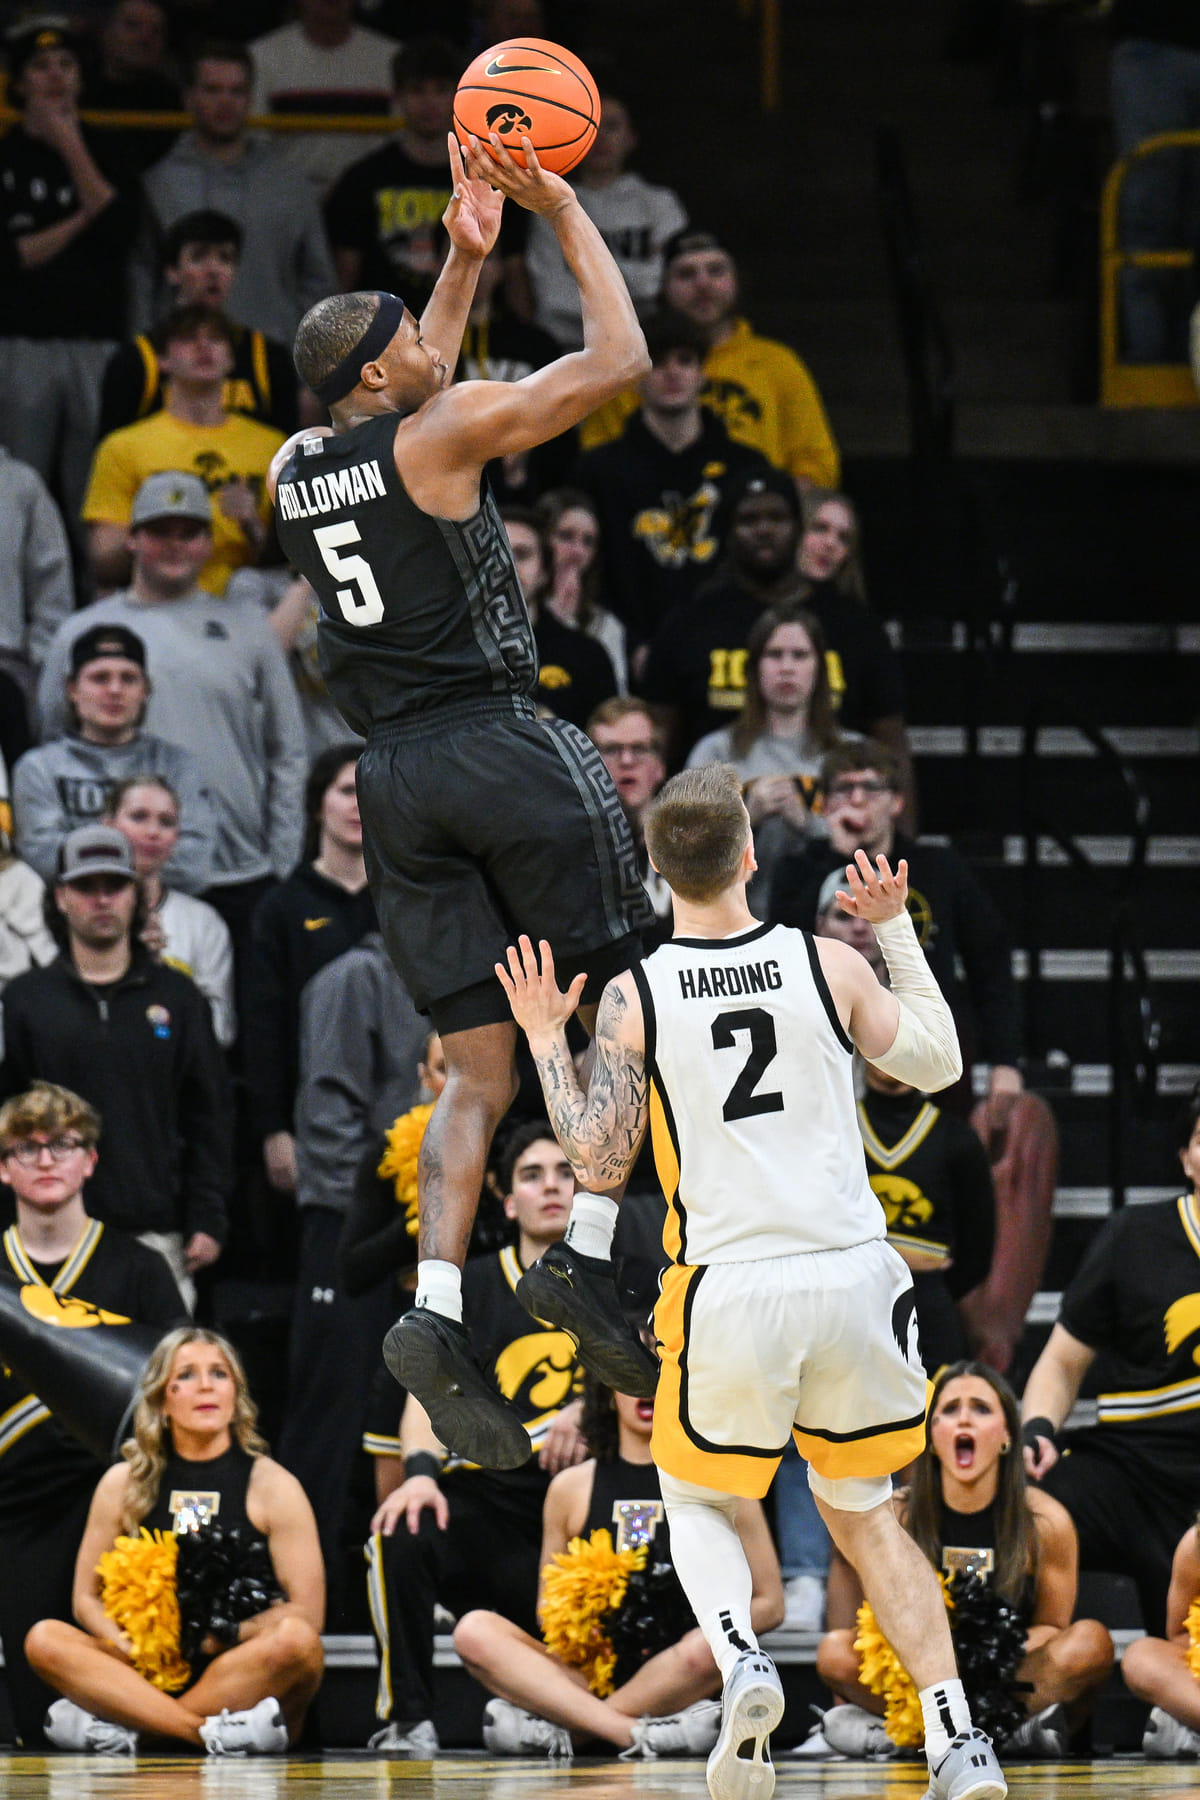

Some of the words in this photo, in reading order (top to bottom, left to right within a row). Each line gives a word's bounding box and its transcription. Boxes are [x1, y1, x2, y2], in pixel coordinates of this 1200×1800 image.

[277, 459, 388, 521] HOLLOMAN
[312, 519, 385, 627] 5
[678, 959, 783, 1000] HARDING
[710, 1007, 785, 1123] 2
